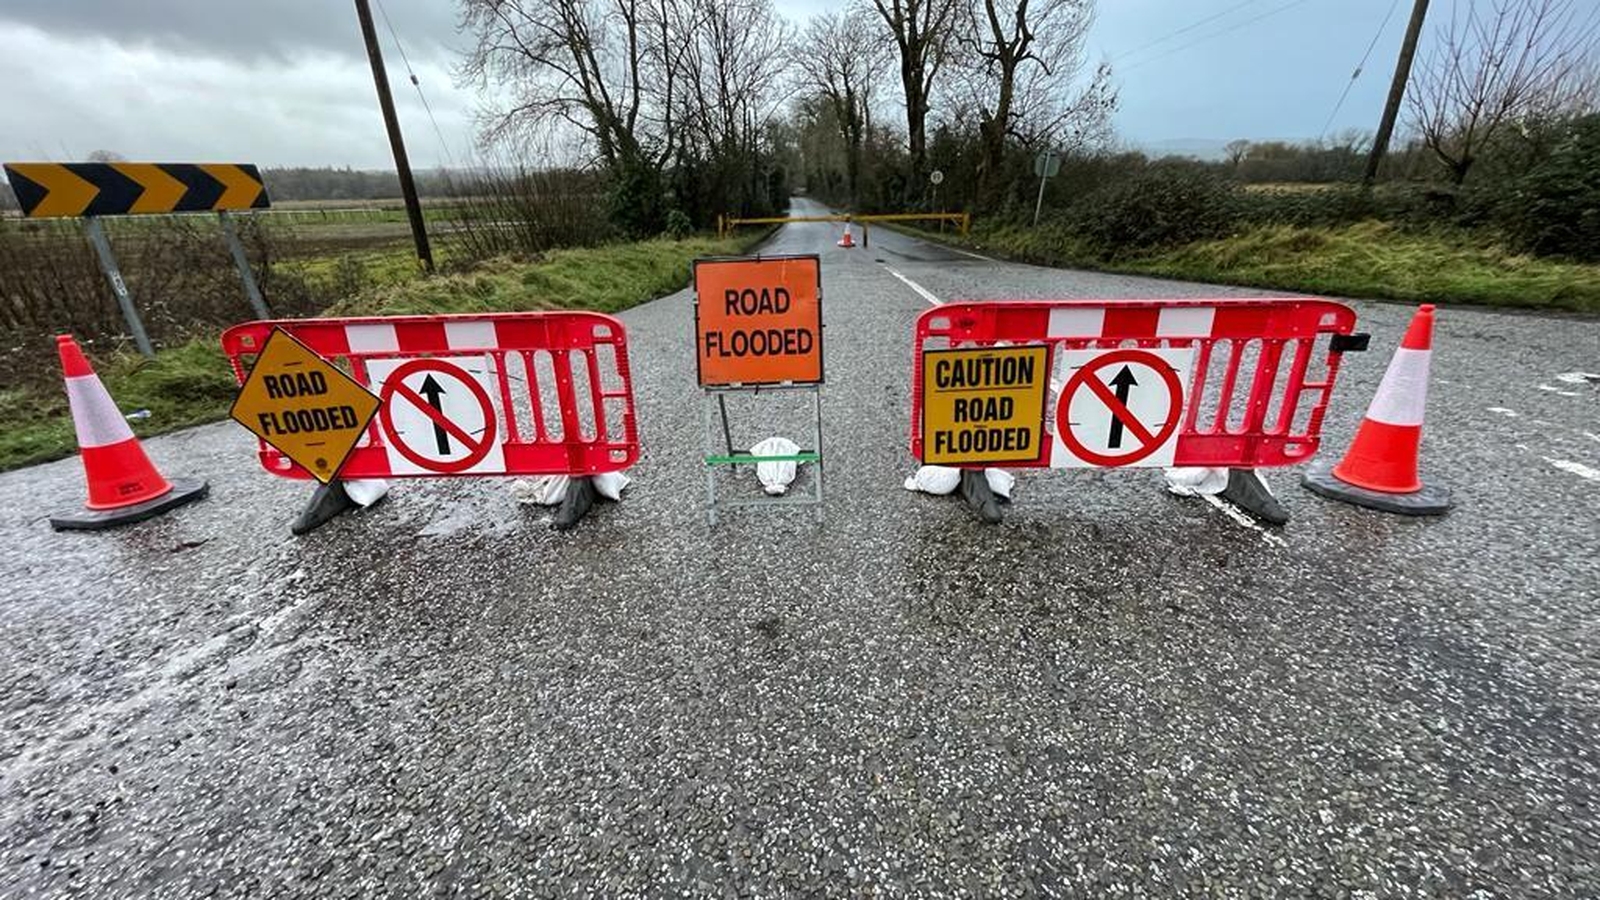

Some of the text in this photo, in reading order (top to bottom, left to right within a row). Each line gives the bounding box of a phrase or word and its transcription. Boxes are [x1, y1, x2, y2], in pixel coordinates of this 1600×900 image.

[725, 287, 790, 316] ROAD
[705, 328, 813, 358] FLOODED
[262, 370, 328, 399] ROAD
[935, 356, 1034, 388] CAUTION
[257, 405, 359, 436] FLOODED
[954, 396, 1014, 423] ROAD
[935, 427, 1031, 454] FLOODED
